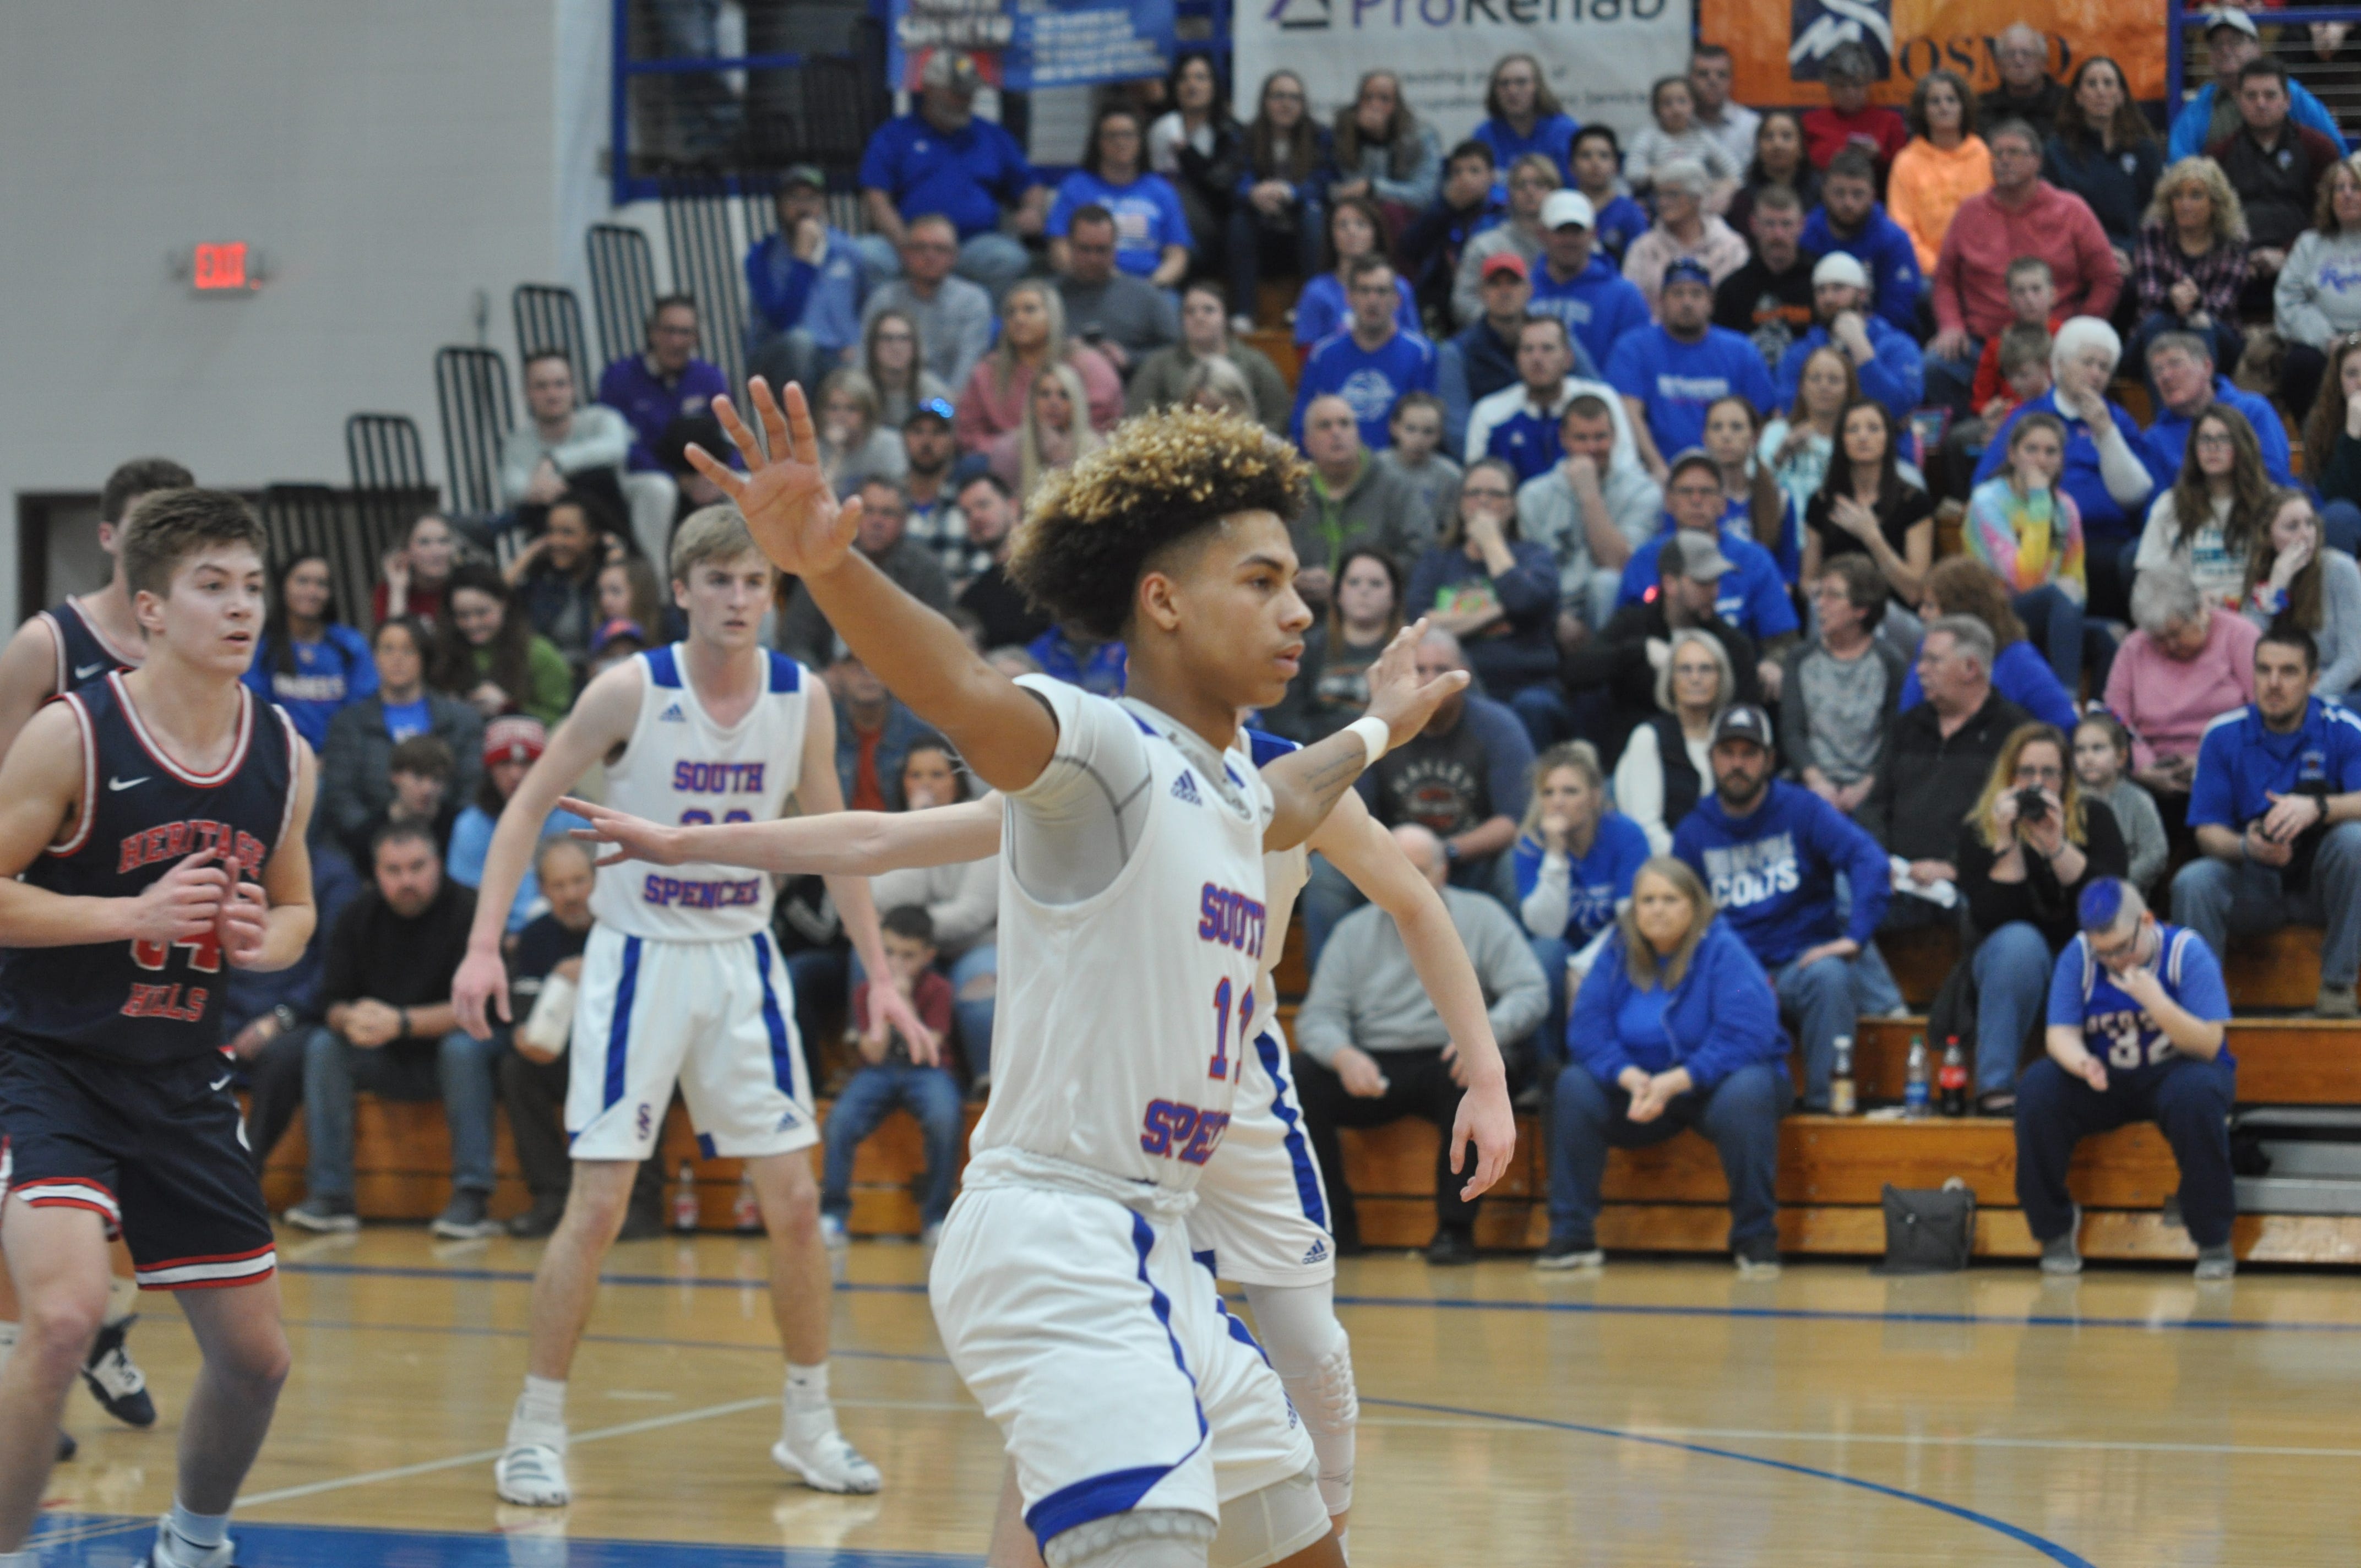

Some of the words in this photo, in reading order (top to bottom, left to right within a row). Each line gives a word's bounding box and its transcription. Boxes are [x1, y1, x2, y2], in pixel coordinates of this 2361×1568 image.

[1899, 35, 2071, 80] OSO
[672, 759, 766, 794] SOUTH
[117, 818, 266, 880] HERITAGE
